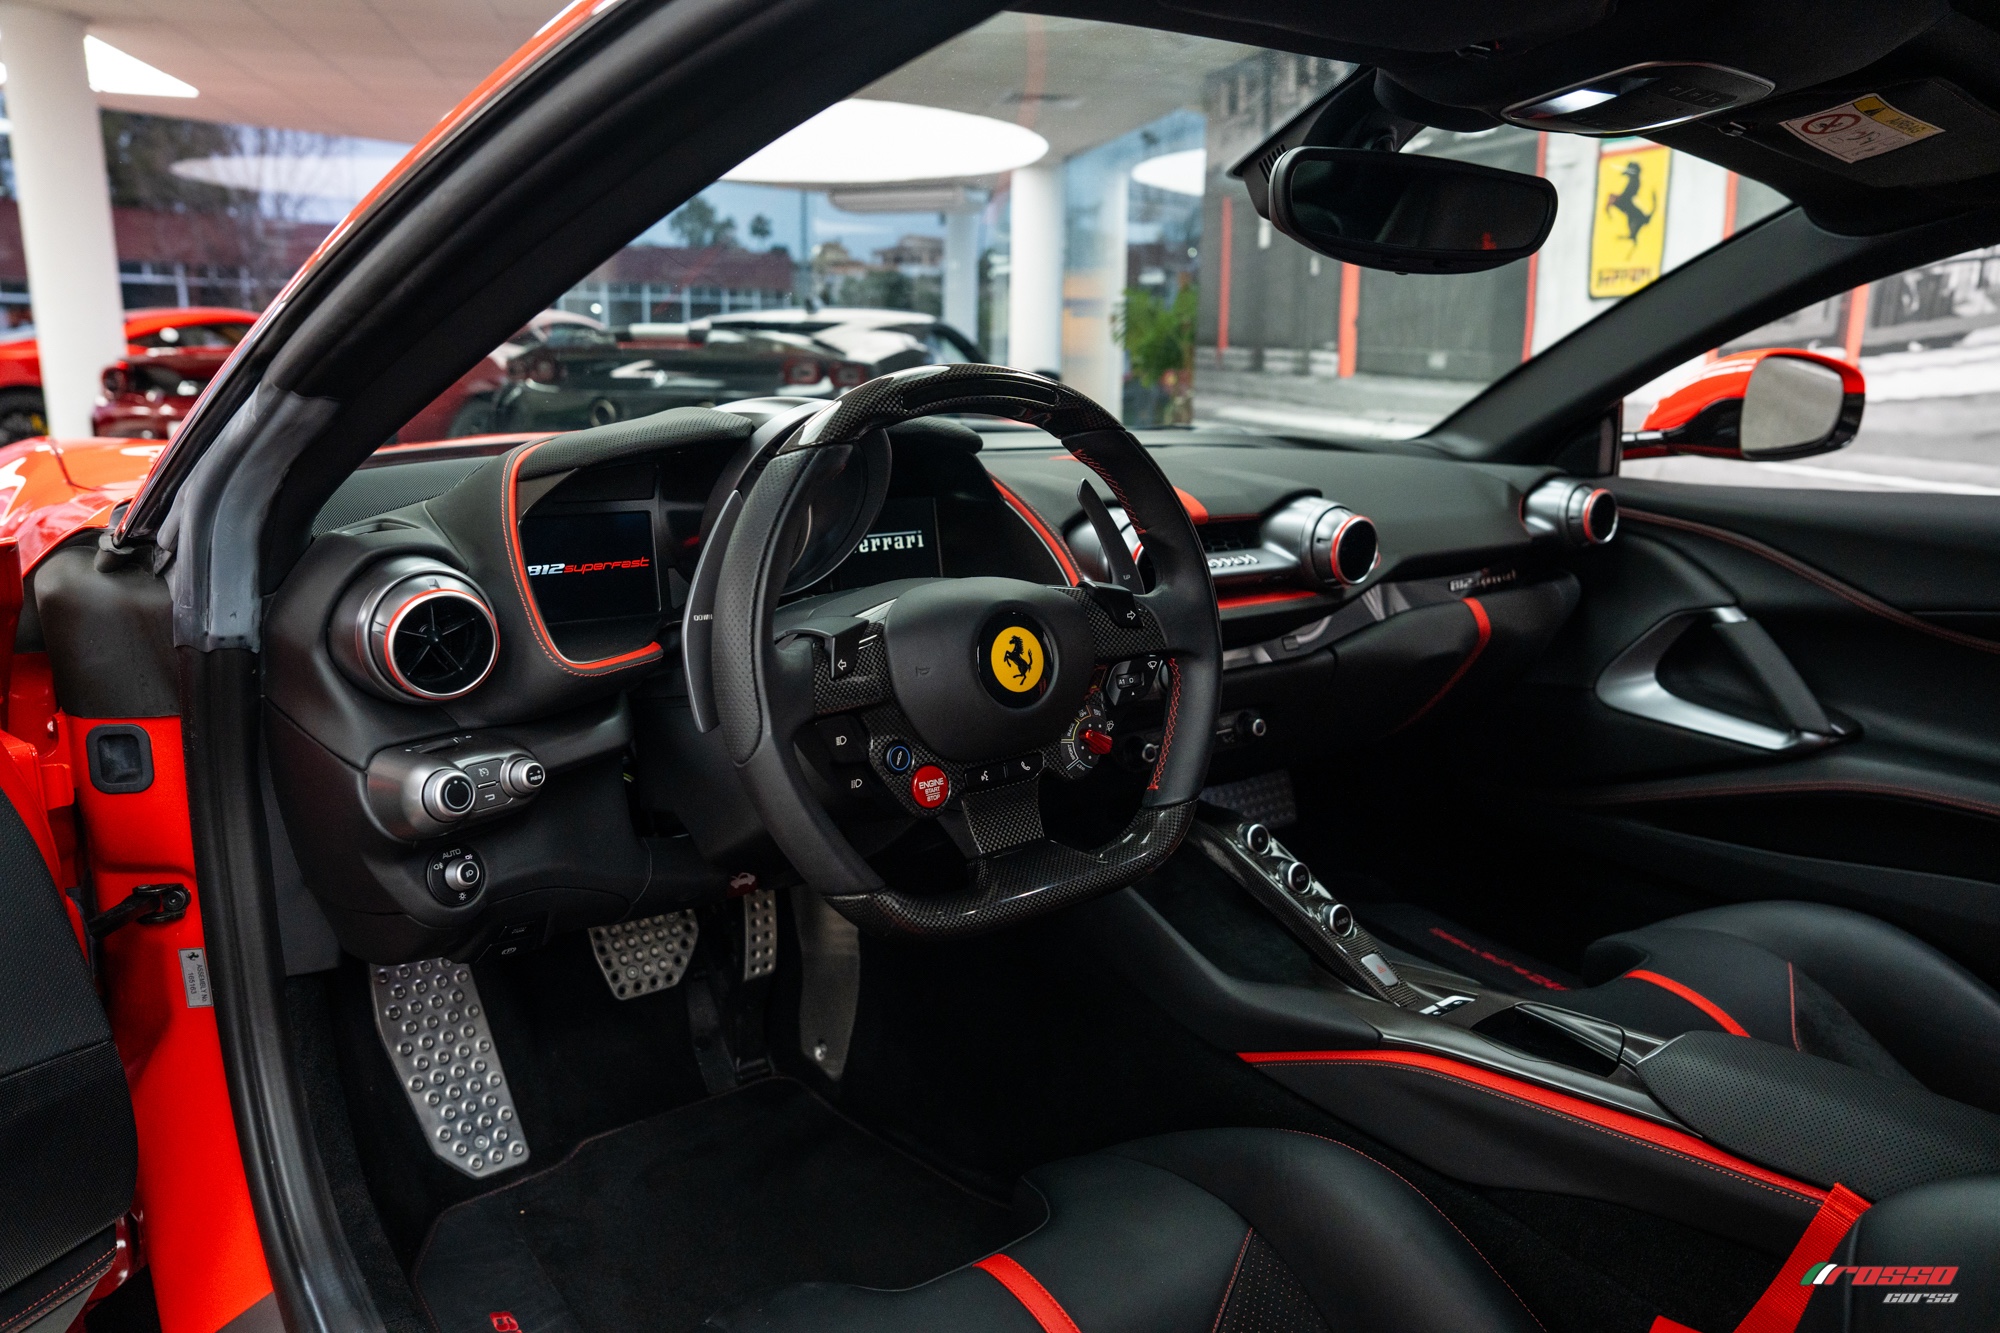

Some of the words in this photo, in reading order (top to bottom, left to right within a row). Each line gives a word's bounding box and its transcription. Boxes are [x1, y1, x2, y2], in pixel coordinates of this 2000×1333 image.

[918, 778, 944, 790] ENGINE
[442, 848, 461, 859] AUTO
[197, 964, 207, 993] ASSEMBLY
